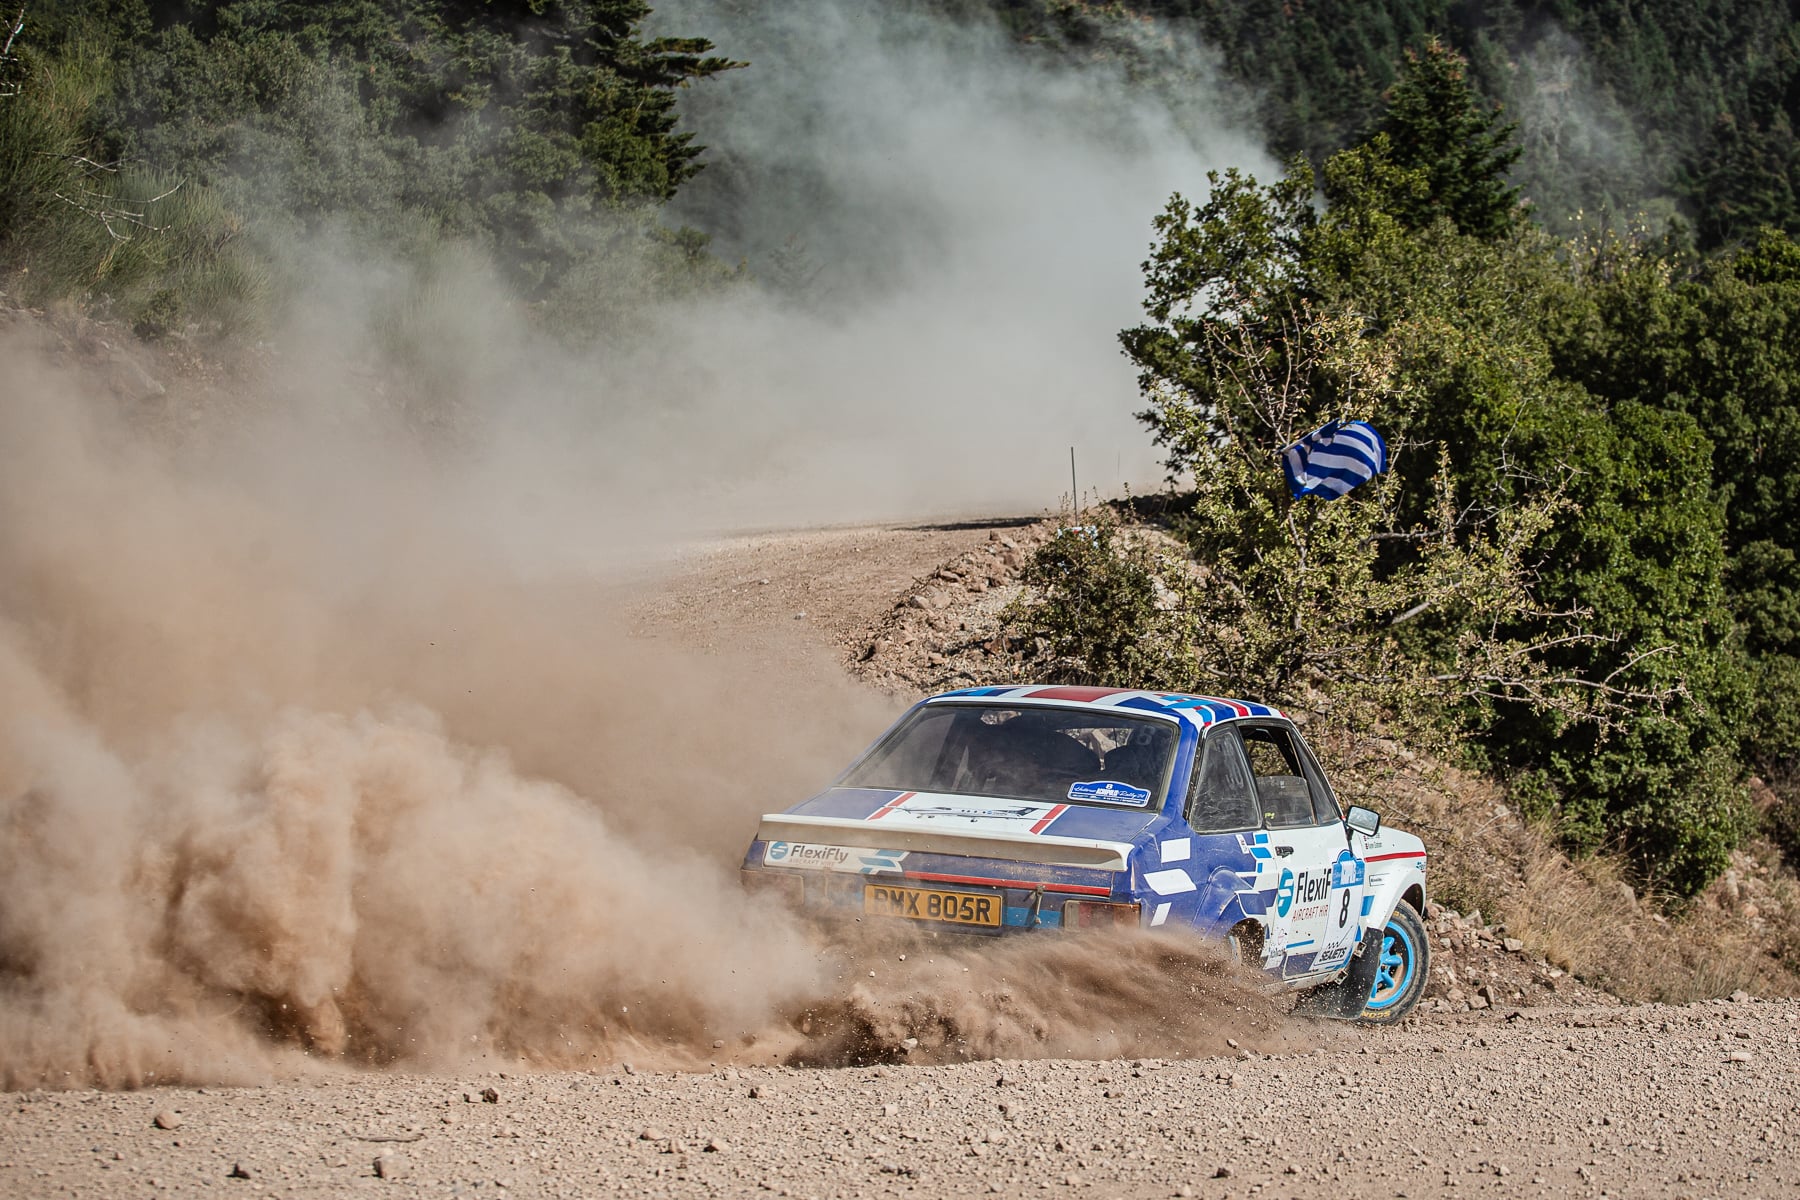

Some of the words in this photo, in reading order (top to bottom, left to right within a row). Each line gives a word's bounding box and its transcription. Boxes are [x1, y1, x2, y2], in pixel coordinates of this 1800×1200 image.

[791, 845, 849, 864] FlexiFly
[1295, 868, 1332, 904] FlexiF
[927, 894, 991, 923] 805R
[1292, 906, 1319, 922] AIRCRAFT
[1339, 888, 1350, 929] 8
